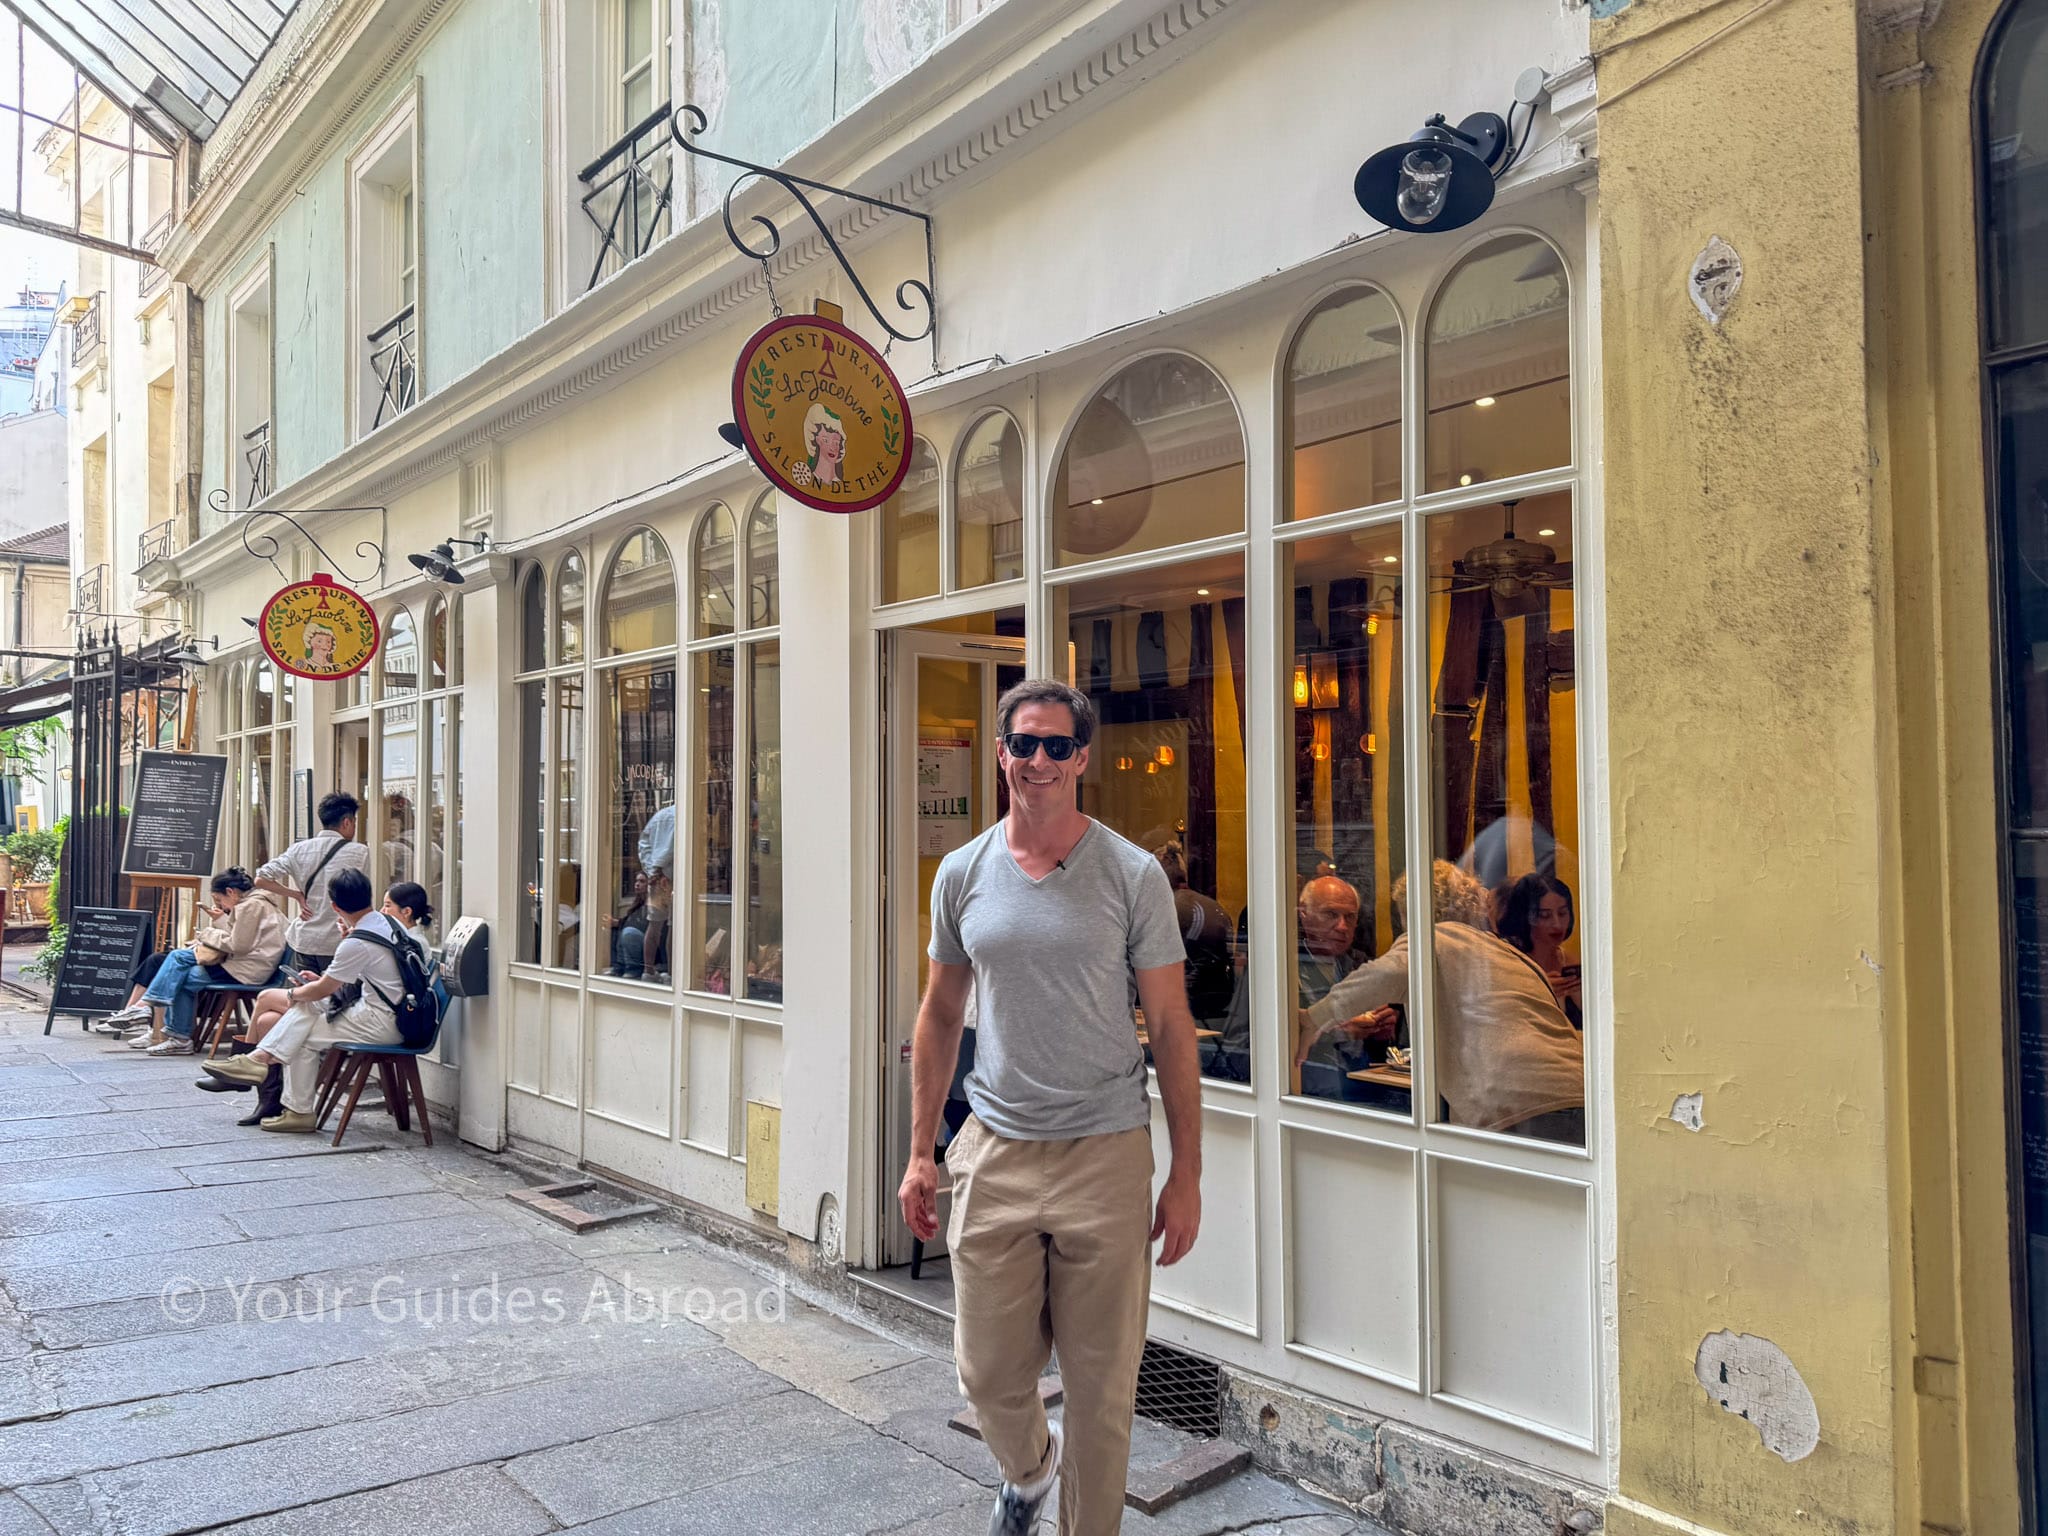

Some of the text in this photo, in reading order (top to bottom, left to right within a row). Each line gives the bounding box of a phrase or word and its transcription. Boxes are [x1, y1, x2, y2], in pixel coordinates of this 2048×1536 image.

[776, 370, 873, 427] La Jacobine
[831, 479, 852, 494] DE
[285, 607, 354, 634] La Jacobine
[322, 663, 341, 674] DE
